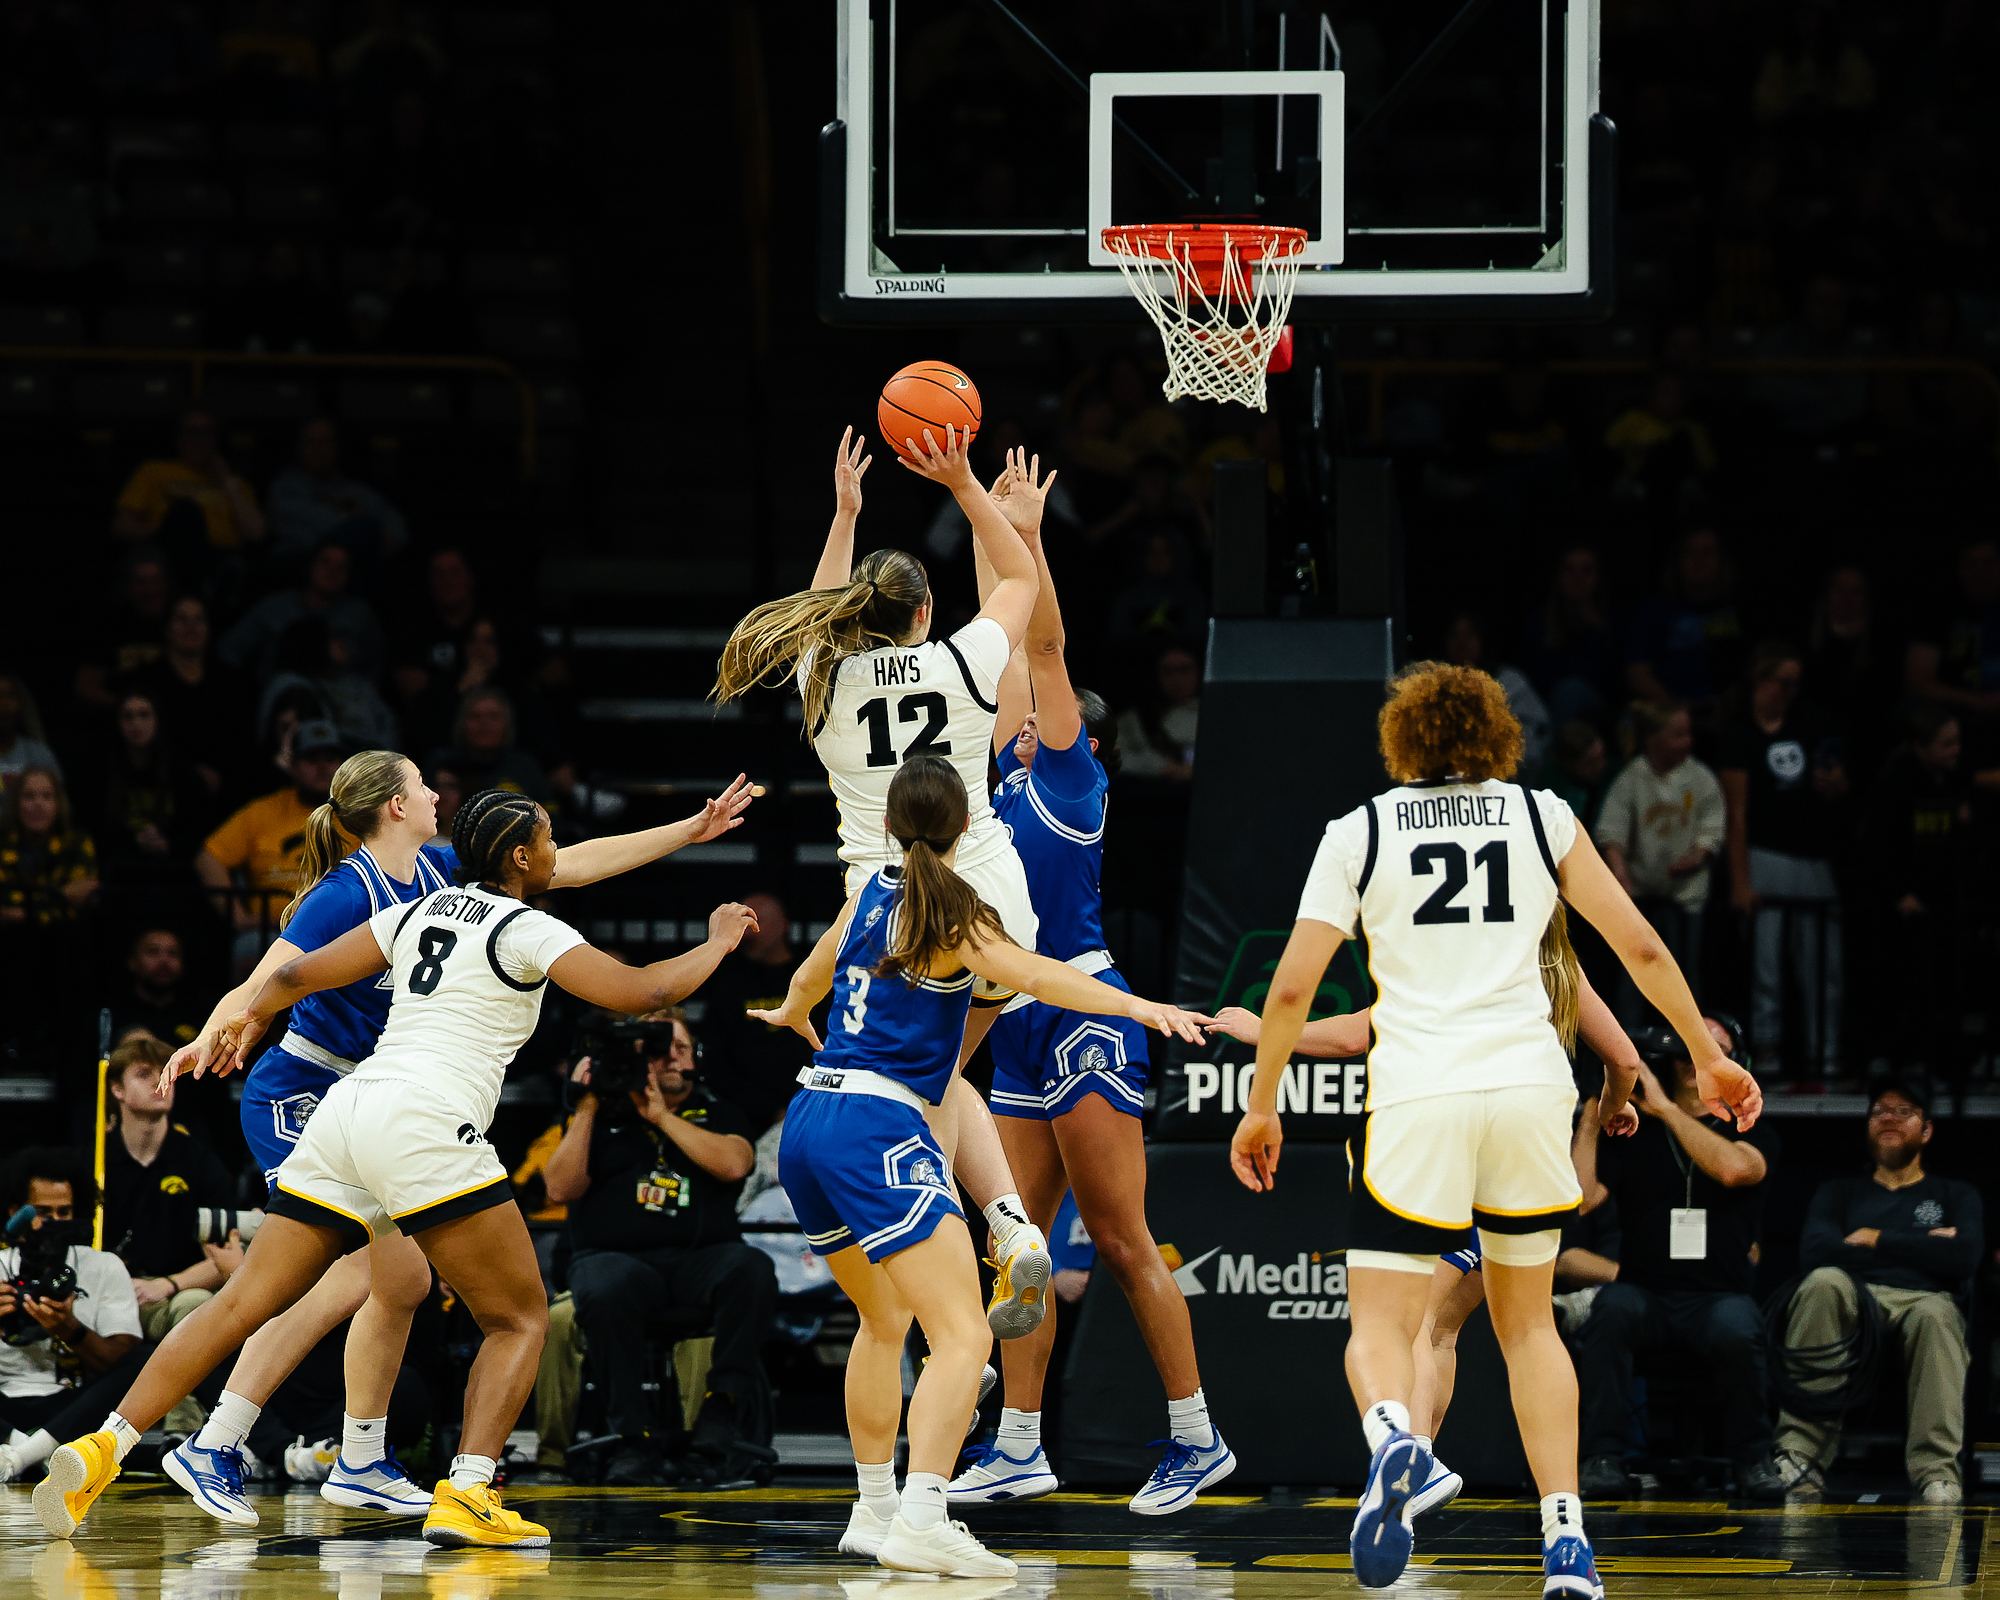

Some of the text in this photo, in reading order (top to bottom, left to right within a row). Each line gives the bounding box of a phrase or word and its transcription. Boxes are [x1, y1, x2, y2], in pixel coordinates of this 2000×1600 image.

[875, 277, 946, 295] SPALDING
[874, 655, 921, 687] HAYS
[856, 691, 953, 768] 12
[1396, 795, 1510, 831] RODRIGUEZ
[1409, 840, 1515, 926] 21
[424, 893, 496, 926] HOUSTON
[408, 925, 458, 997] 8
[842, 964, 872, 1036] 3
[1216, 1252, 1348, 1295] Media
[1267, 1300, 1351, 1320] COU
